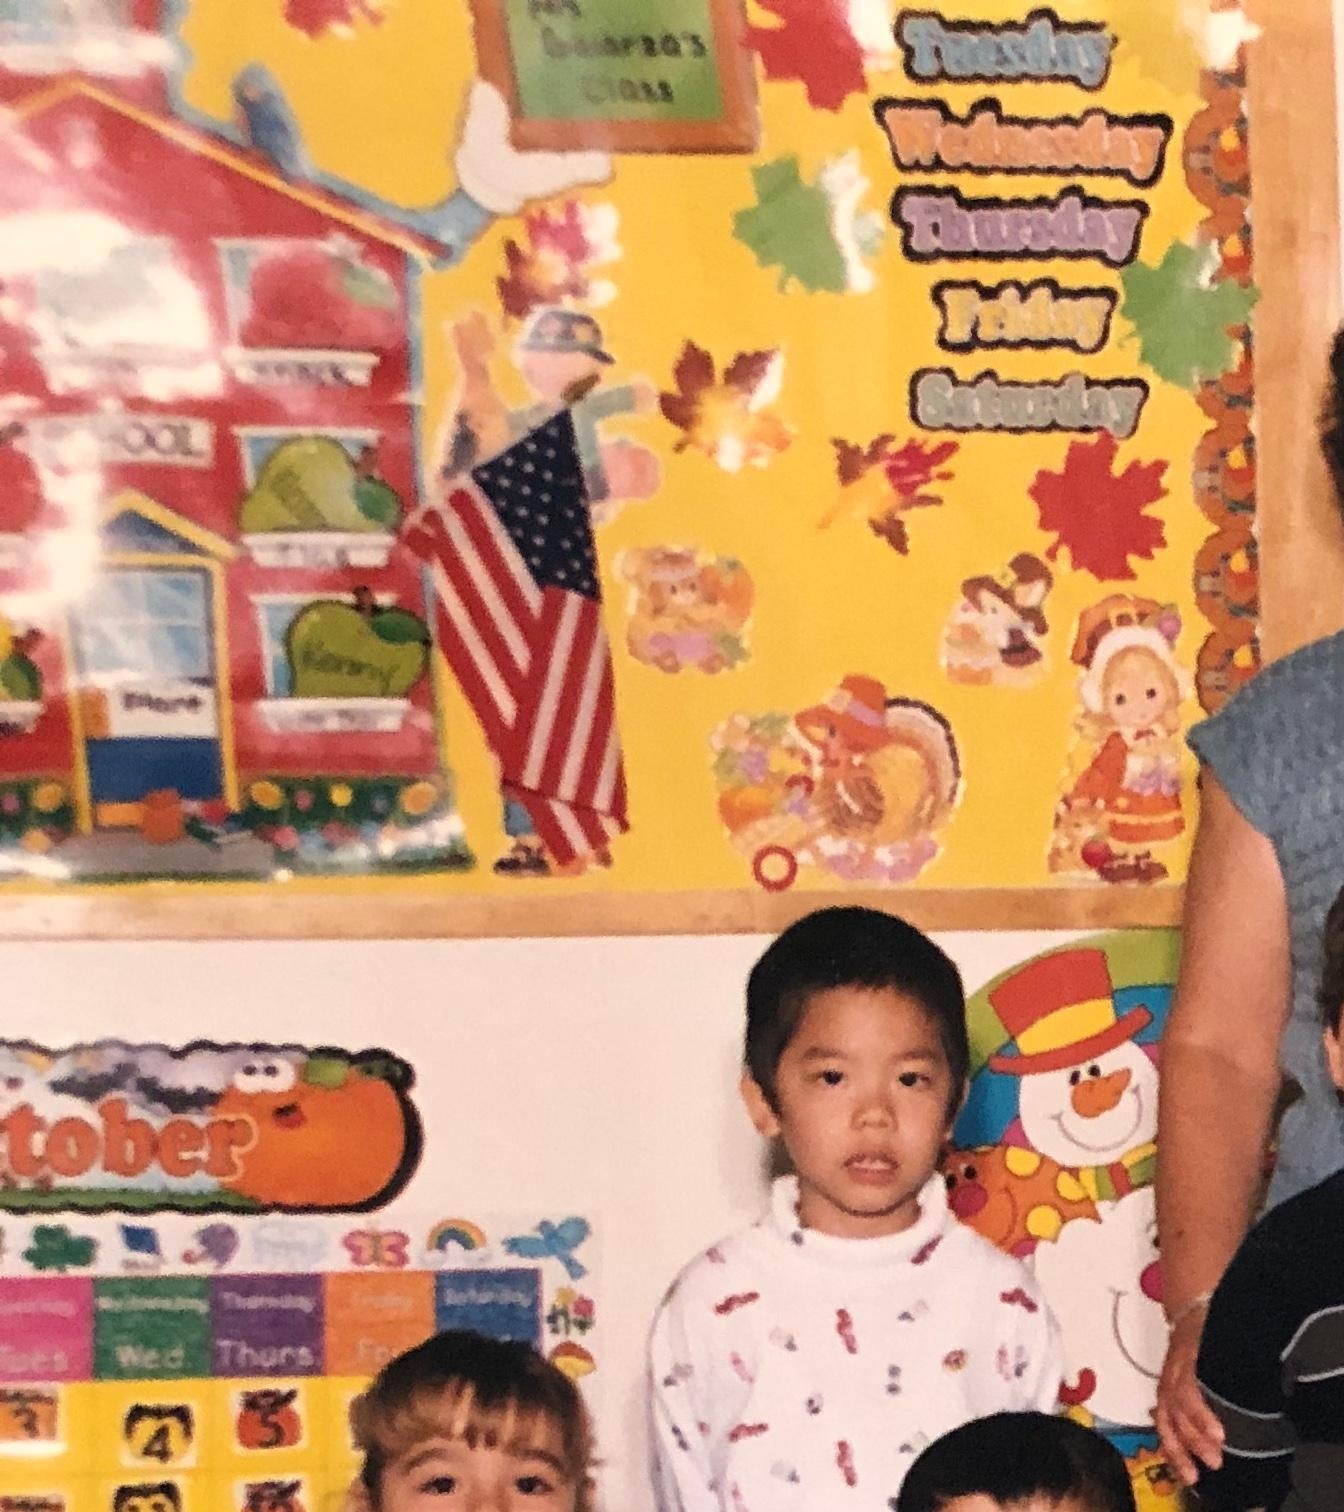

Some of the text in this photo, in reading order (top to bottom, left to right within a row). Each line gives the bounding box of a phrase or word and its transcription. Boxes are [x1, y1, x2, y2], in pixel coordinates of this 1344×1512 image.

[898, 12, 1116, 89] Tuesday
[879, 102, 1168, 185] Wednesday
[896, 189, 1146, 265] Thursday
[936, 282, 1116, 352] Friday
[913, 371, 1146, 439] Saturday
[116, 1344, 185, 1369] Wed
[215, 1338, 315, 1368] Thurs
[142, 1425, 173, 1463] 4
[257, 1407, 287, 1448] 5
